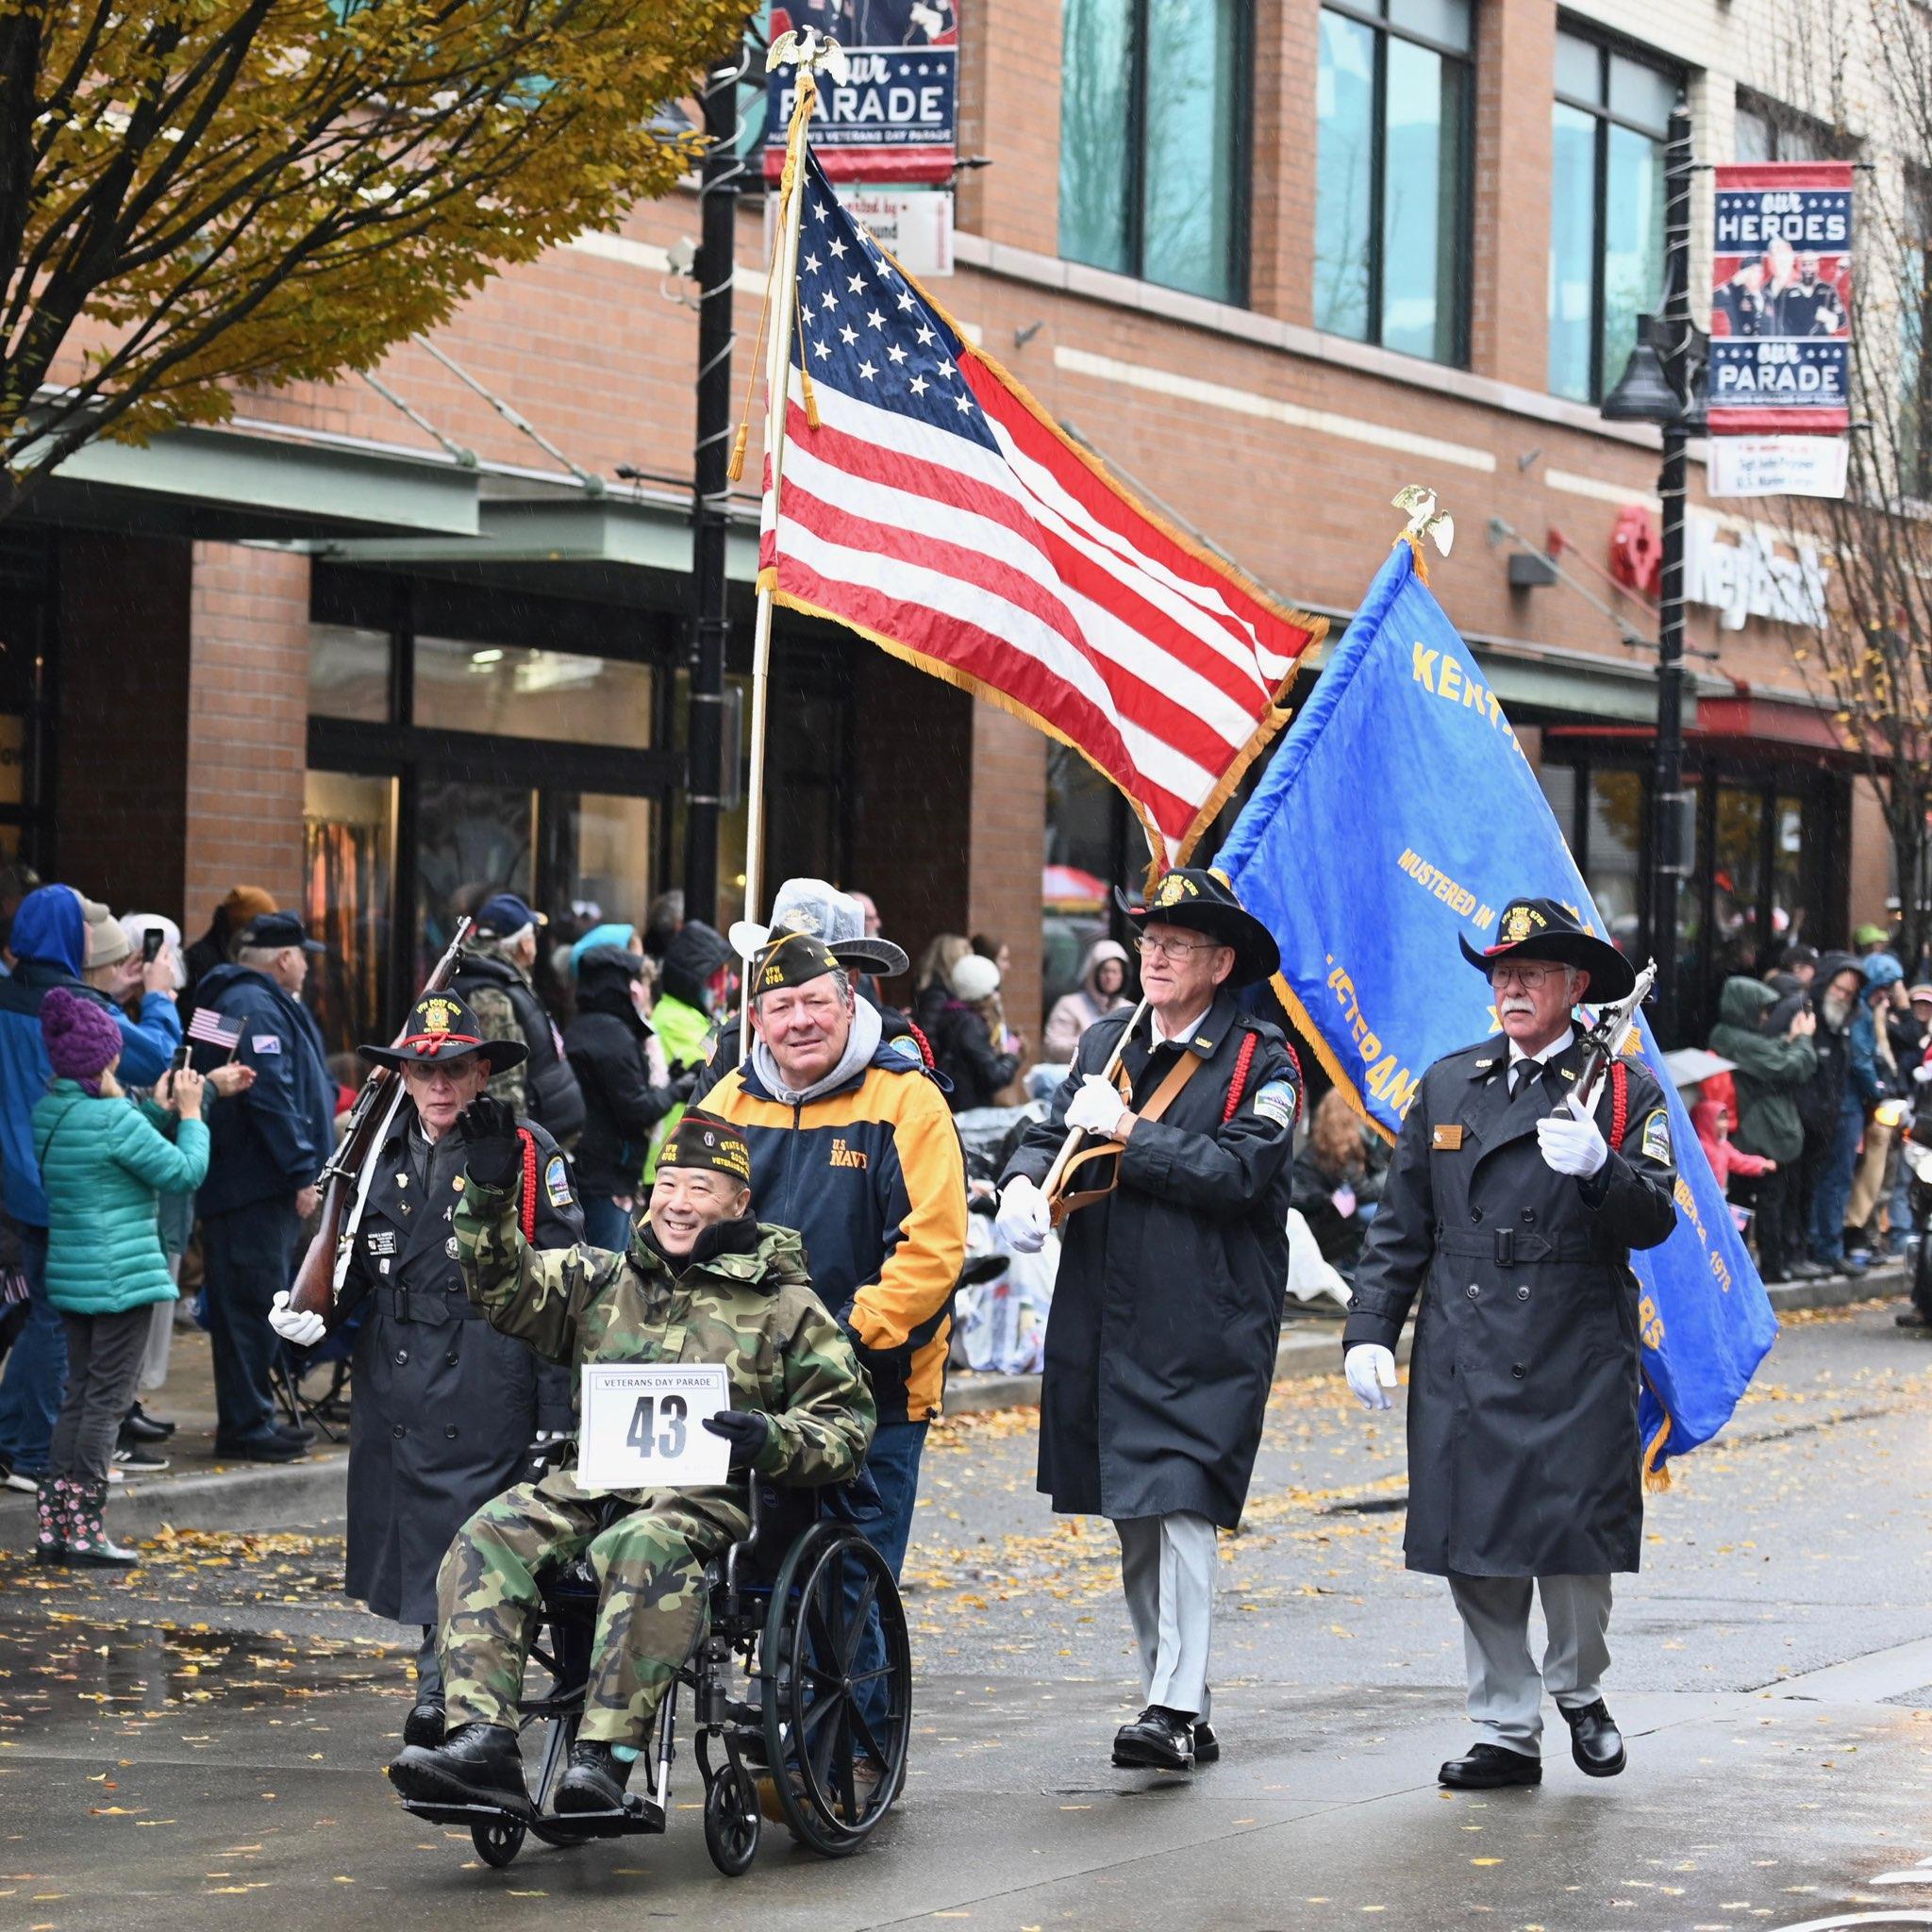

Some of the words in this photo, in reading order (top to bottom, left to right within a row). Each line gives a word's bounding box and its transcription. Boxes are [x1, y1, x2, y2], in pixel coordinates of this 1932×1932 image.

[779, 86, 943, 123] PARADE
[884, 130, 907, 142] DAY
[908, 128, 952, 142] PARADE
[1718, 213, 1846, 242] HEROES
[1717, 363, 1840, 391] PARADE
[1397, 847, 1476, 917] MUSTERED
[1472, 904, 1496, 930] IN
[765, 965, 780, 976] VFW
[1710, 1251, 1732, 1292] 1978
[604, 1378, 653, 1387] VETERANS
[655, 1378, 674, 1387] DAY
[676, 1377, 711, 1387] PARADE
[626, 1394, 688, 1458] 43
